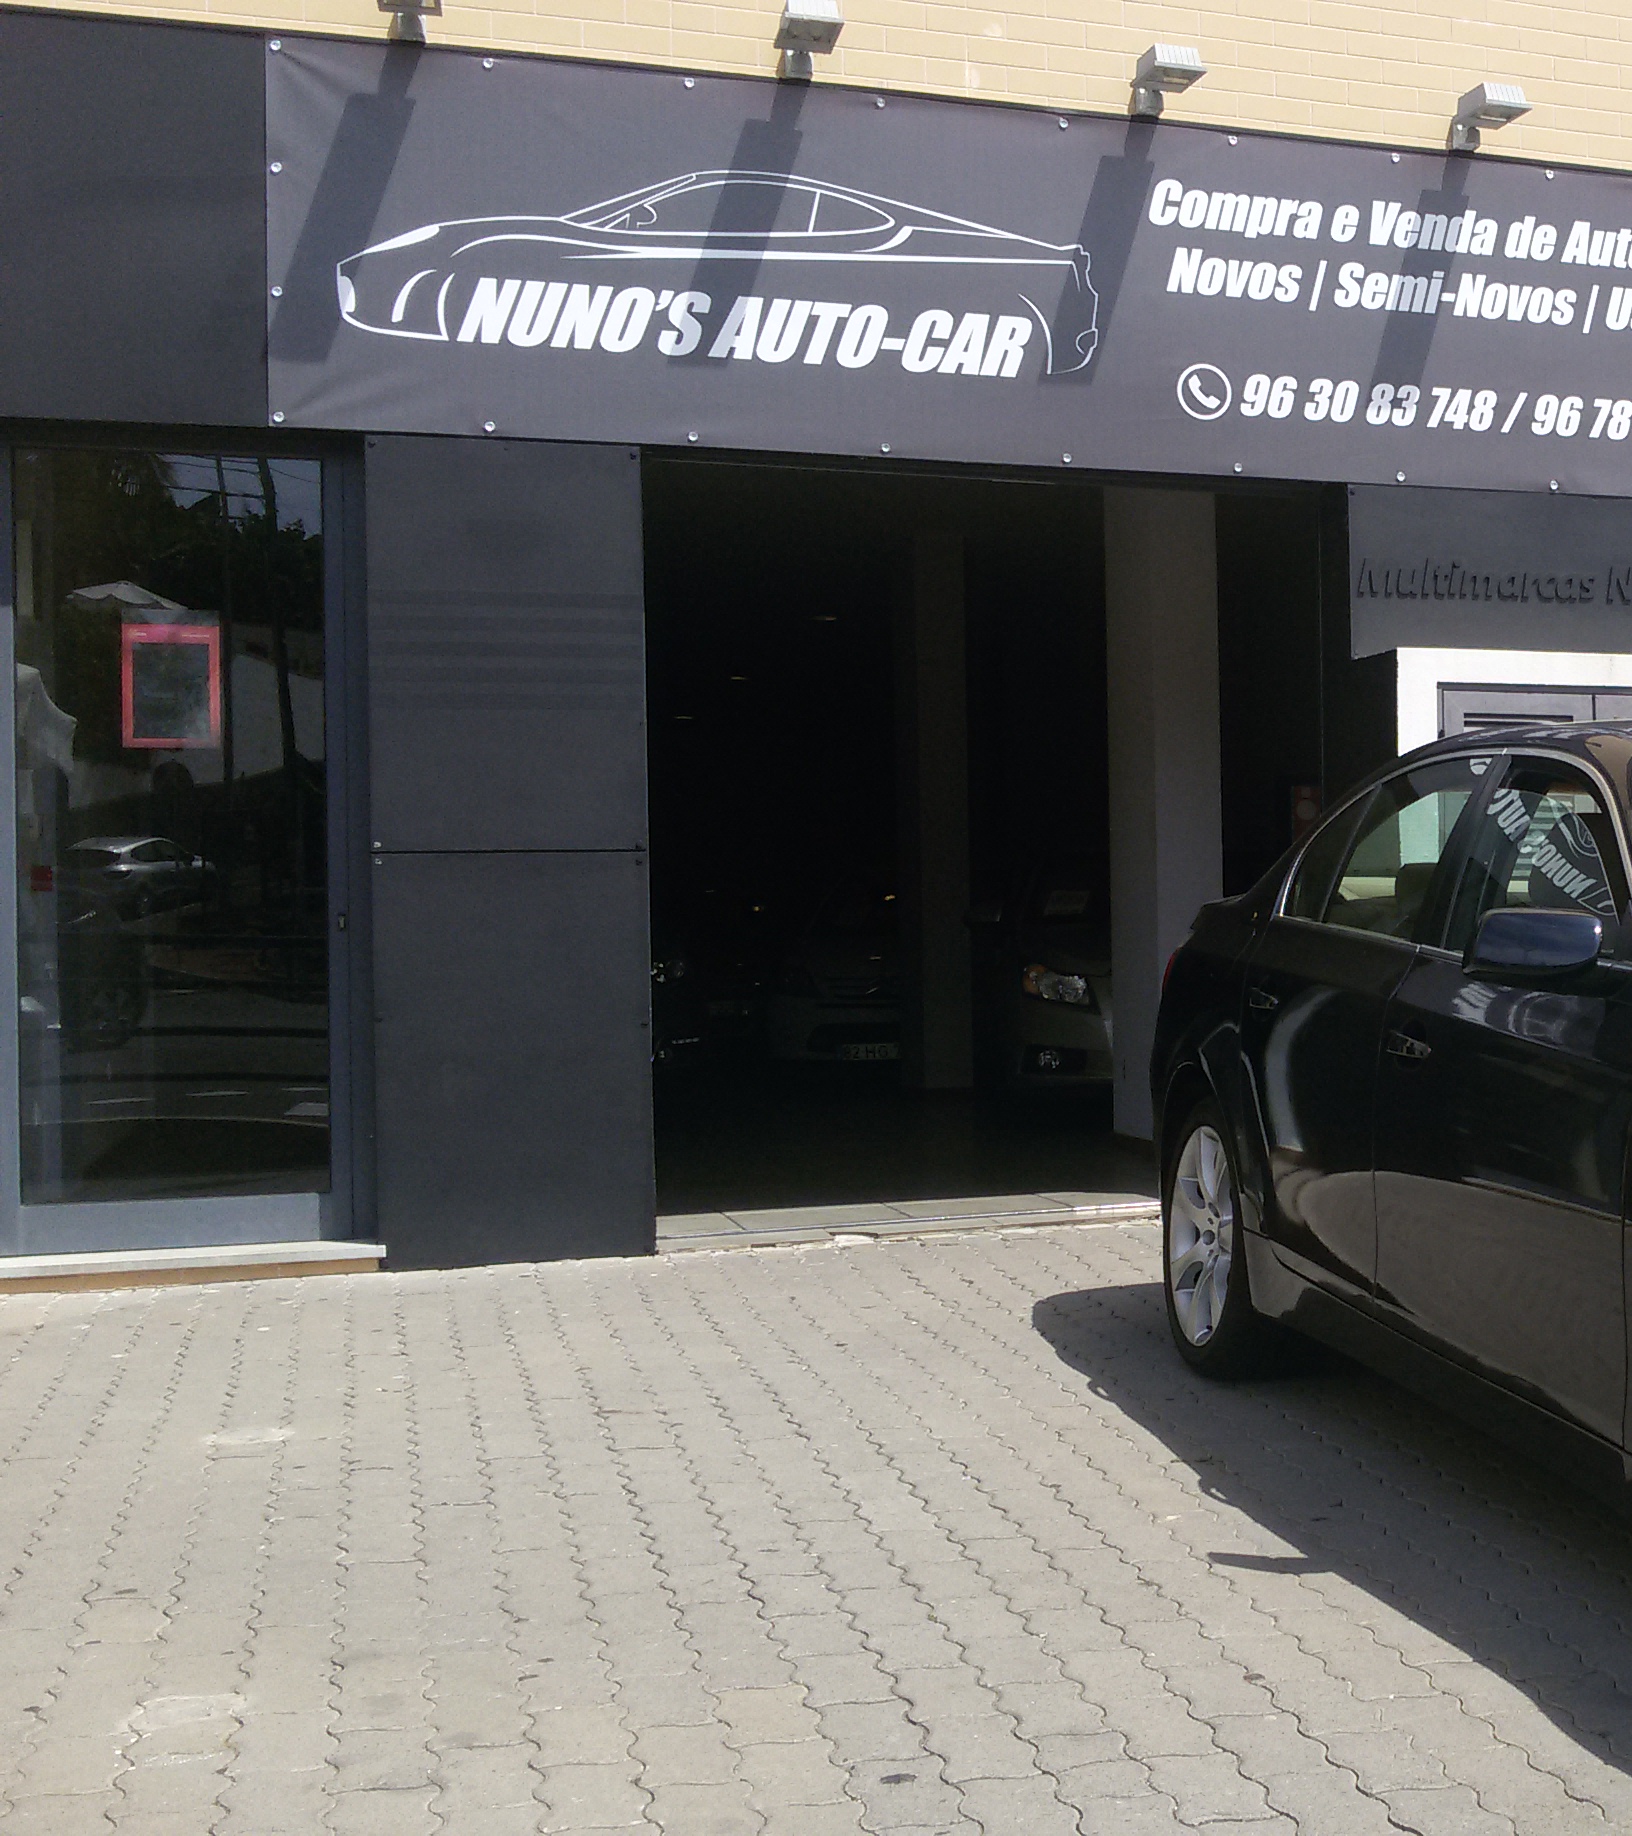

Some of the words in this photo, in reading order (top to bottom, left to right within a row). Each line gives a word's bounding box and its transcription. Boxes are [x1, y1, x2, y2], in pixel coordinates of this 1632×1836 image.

[1149, 179, 1323, 239] Compra
[1331, 205, 1359, 242] e
[1369, 201, 1498, 255] Venda
[1505, 214, 1557, 261] de
[1166, 246, 1302, 303] Novos
[1334, 261, 1577, 326] Semi-Novos
[456, 276, 712, 356] NUNO'S
[707, 295, 1033, 378] AUTO-CAR
[1239, 373, 1297, 418] 96
[1303, 378, 1359, 423] 30
[1366, 383, 1420, 427] 83
[1427, 387, 1497, 432] 748
[1531, 394, 1583, 437] 96
[1355, 558, 1595, 604] Multimarcas
